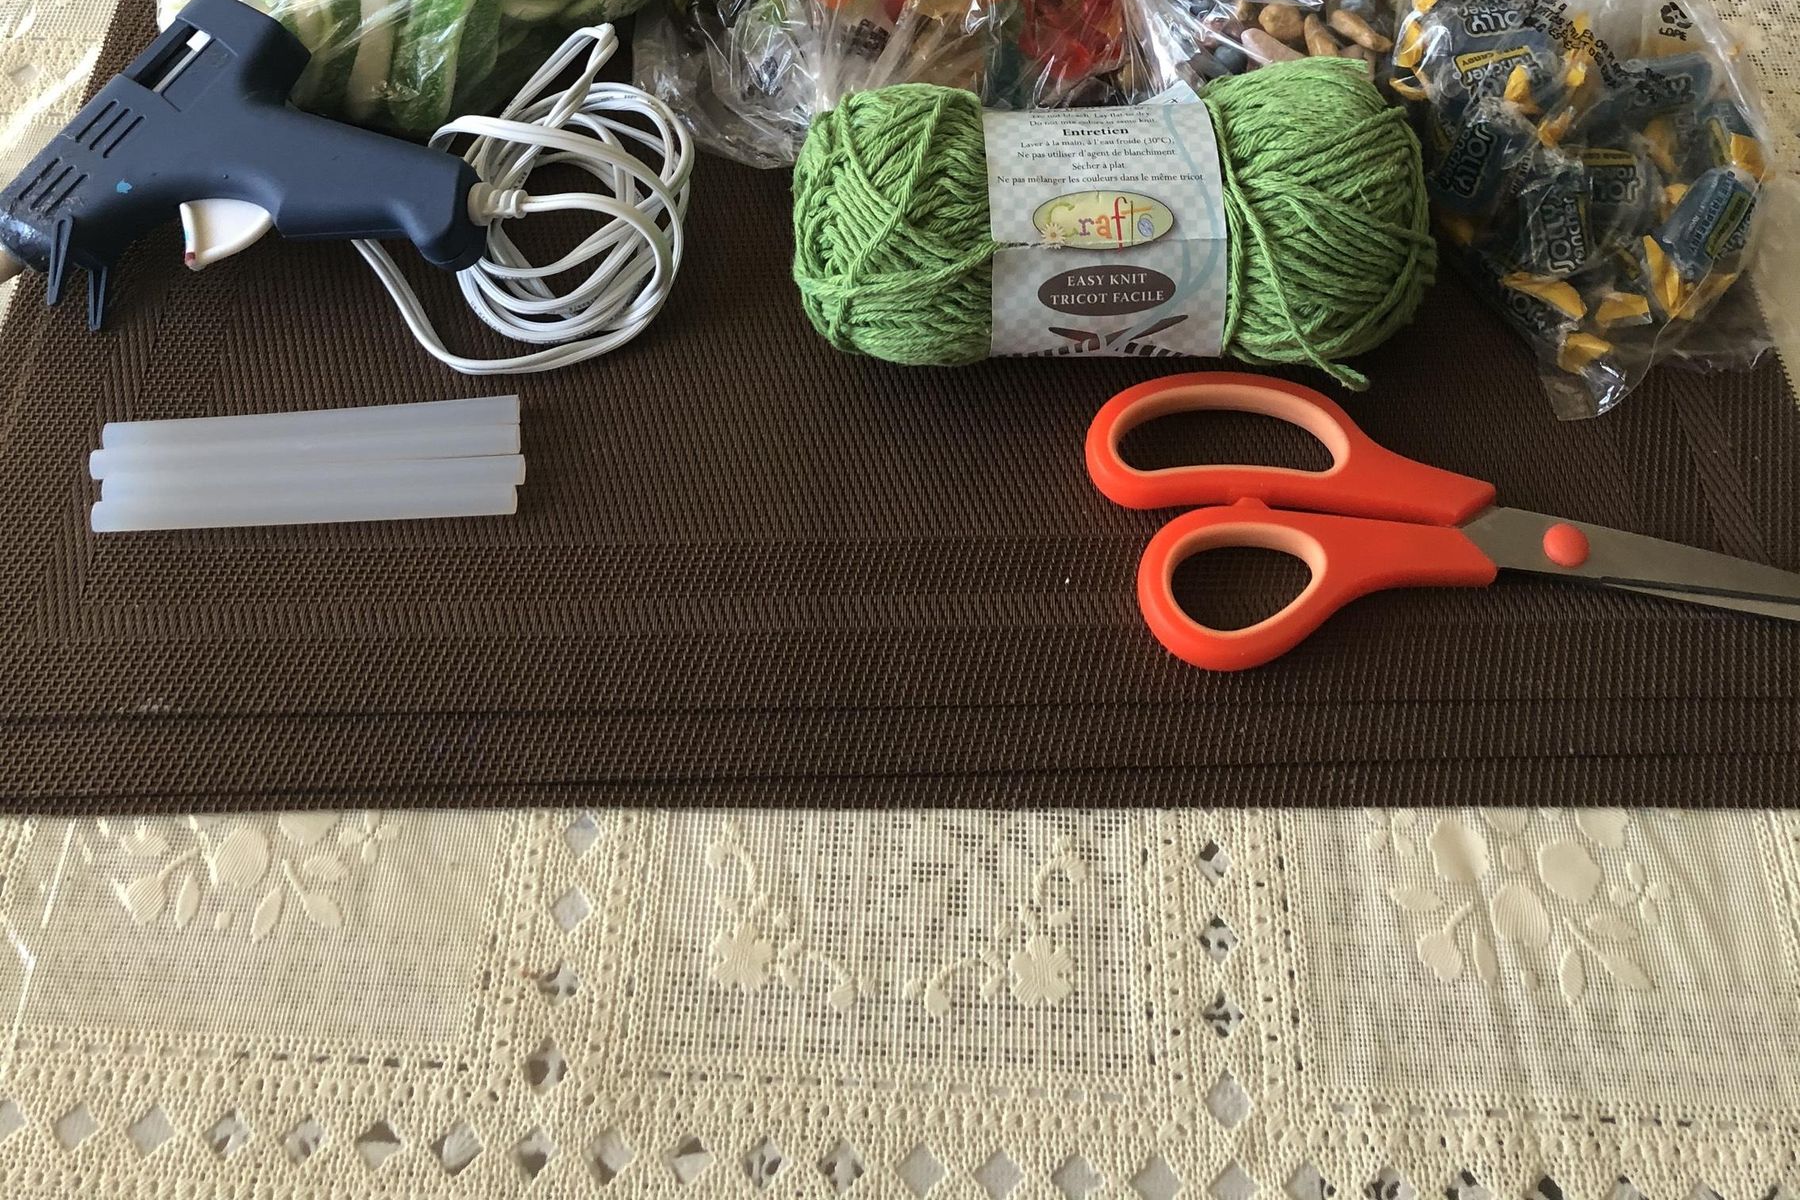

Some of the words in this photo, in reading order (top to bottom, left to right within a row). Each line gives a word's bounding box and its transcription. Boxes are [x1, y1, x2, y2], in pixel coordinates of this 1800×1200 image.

[1472, 11, 1523, 32] OLLY
[1063, 127, 1129, 137] Entretien
[1020, 141, 1042, 149] Laver
[1117, 137, 1141, 145] froide
[1017, 151, 1030, 159] Ne
[1032, 153, 1045, 161] pas
[1047, 150, 1076, 158] utiliser
[1078, 149, 1109, 160] d'agent
[1112, 149, 1122, 157] de
[1072, 162, 1100, 171] Sécher
[997, 176, 1010, 184] Ne
[1012, 177, 1025, 186] pas
[1028, 175, 1067, 186] mélanger
[1069, 176, 1080, 184] les
[1082, 174, 1118, 183] couleurs
[1120, 173, 1139, 182] dans
[1141, 173, 1149, 182] le
[1151, 172, 1178, 182] même
[1067, 274, 1105, 287] EASY
[1110, 272, 1148, 286] KNIT
[1050, 293, 1109, 306] TRICOT
[1113, 290, 1165, 303] FACILE
